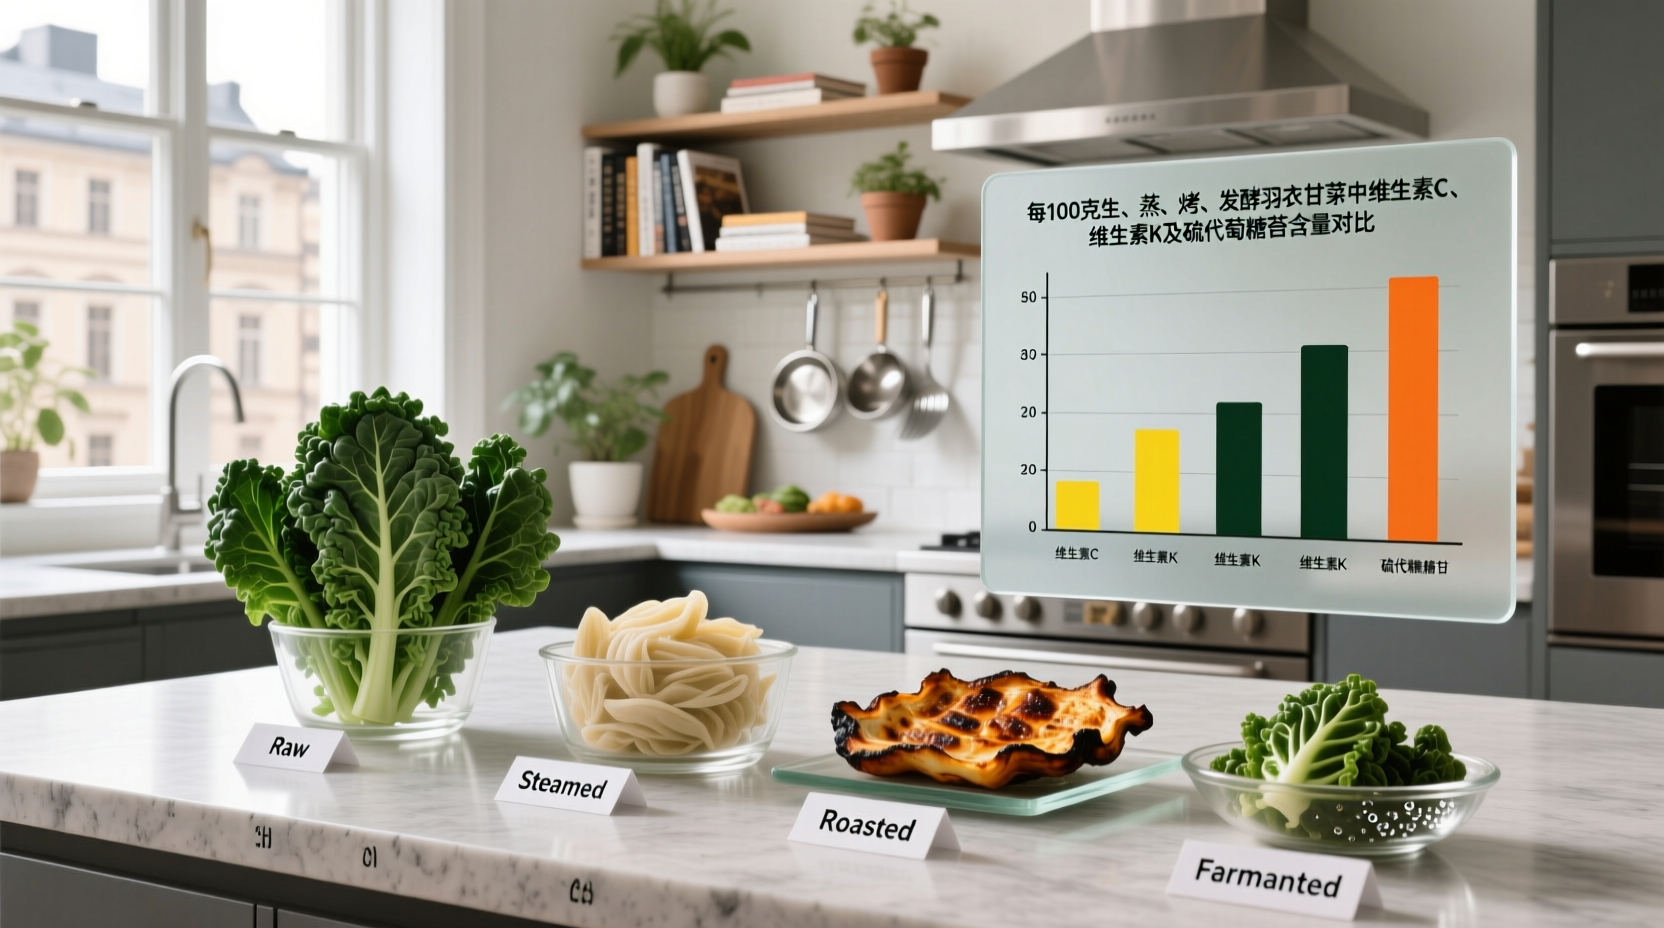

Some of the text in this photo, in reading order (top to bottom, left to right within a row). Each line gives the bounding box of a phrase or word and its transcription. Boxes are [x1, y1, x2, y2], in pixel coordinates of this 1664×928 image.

[1020, 406, 1037, 418] 20
[1020, 463, 1037, 476] 20
[1028, 520, 1037, 533] 0
[269, 736, 310, 759] Raw
[518, 770, 608, 800] Steamed
[819, 809, 916, 842] Roasted
[1195, 858, 1342, 899] Farmanted
